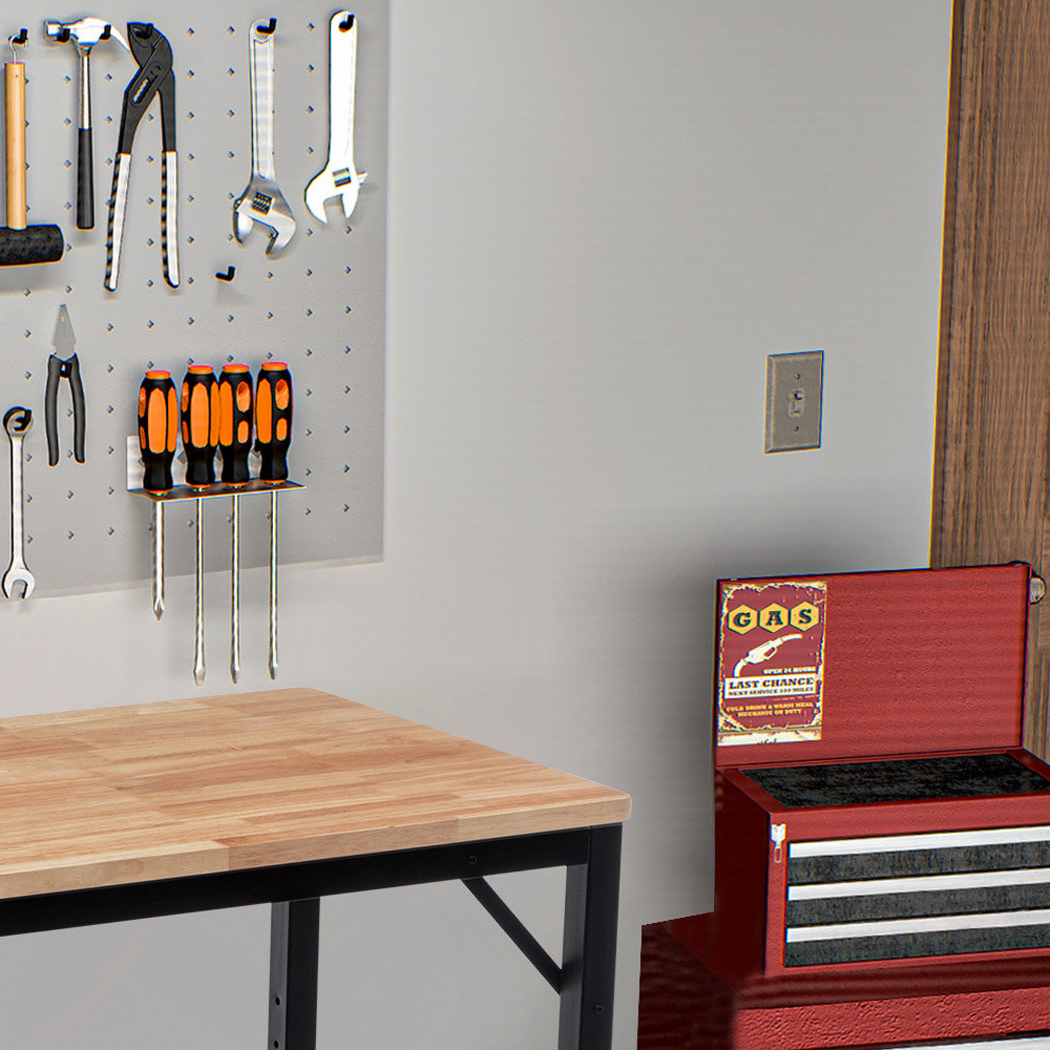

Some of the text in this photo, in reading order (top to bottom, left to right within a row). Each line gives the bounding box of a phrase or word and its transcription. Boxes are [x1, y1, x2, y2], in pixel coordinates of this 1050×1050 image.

[733, 608, 813, 627] GAS
[729, 677, 814, 690] LAST CHANCE
